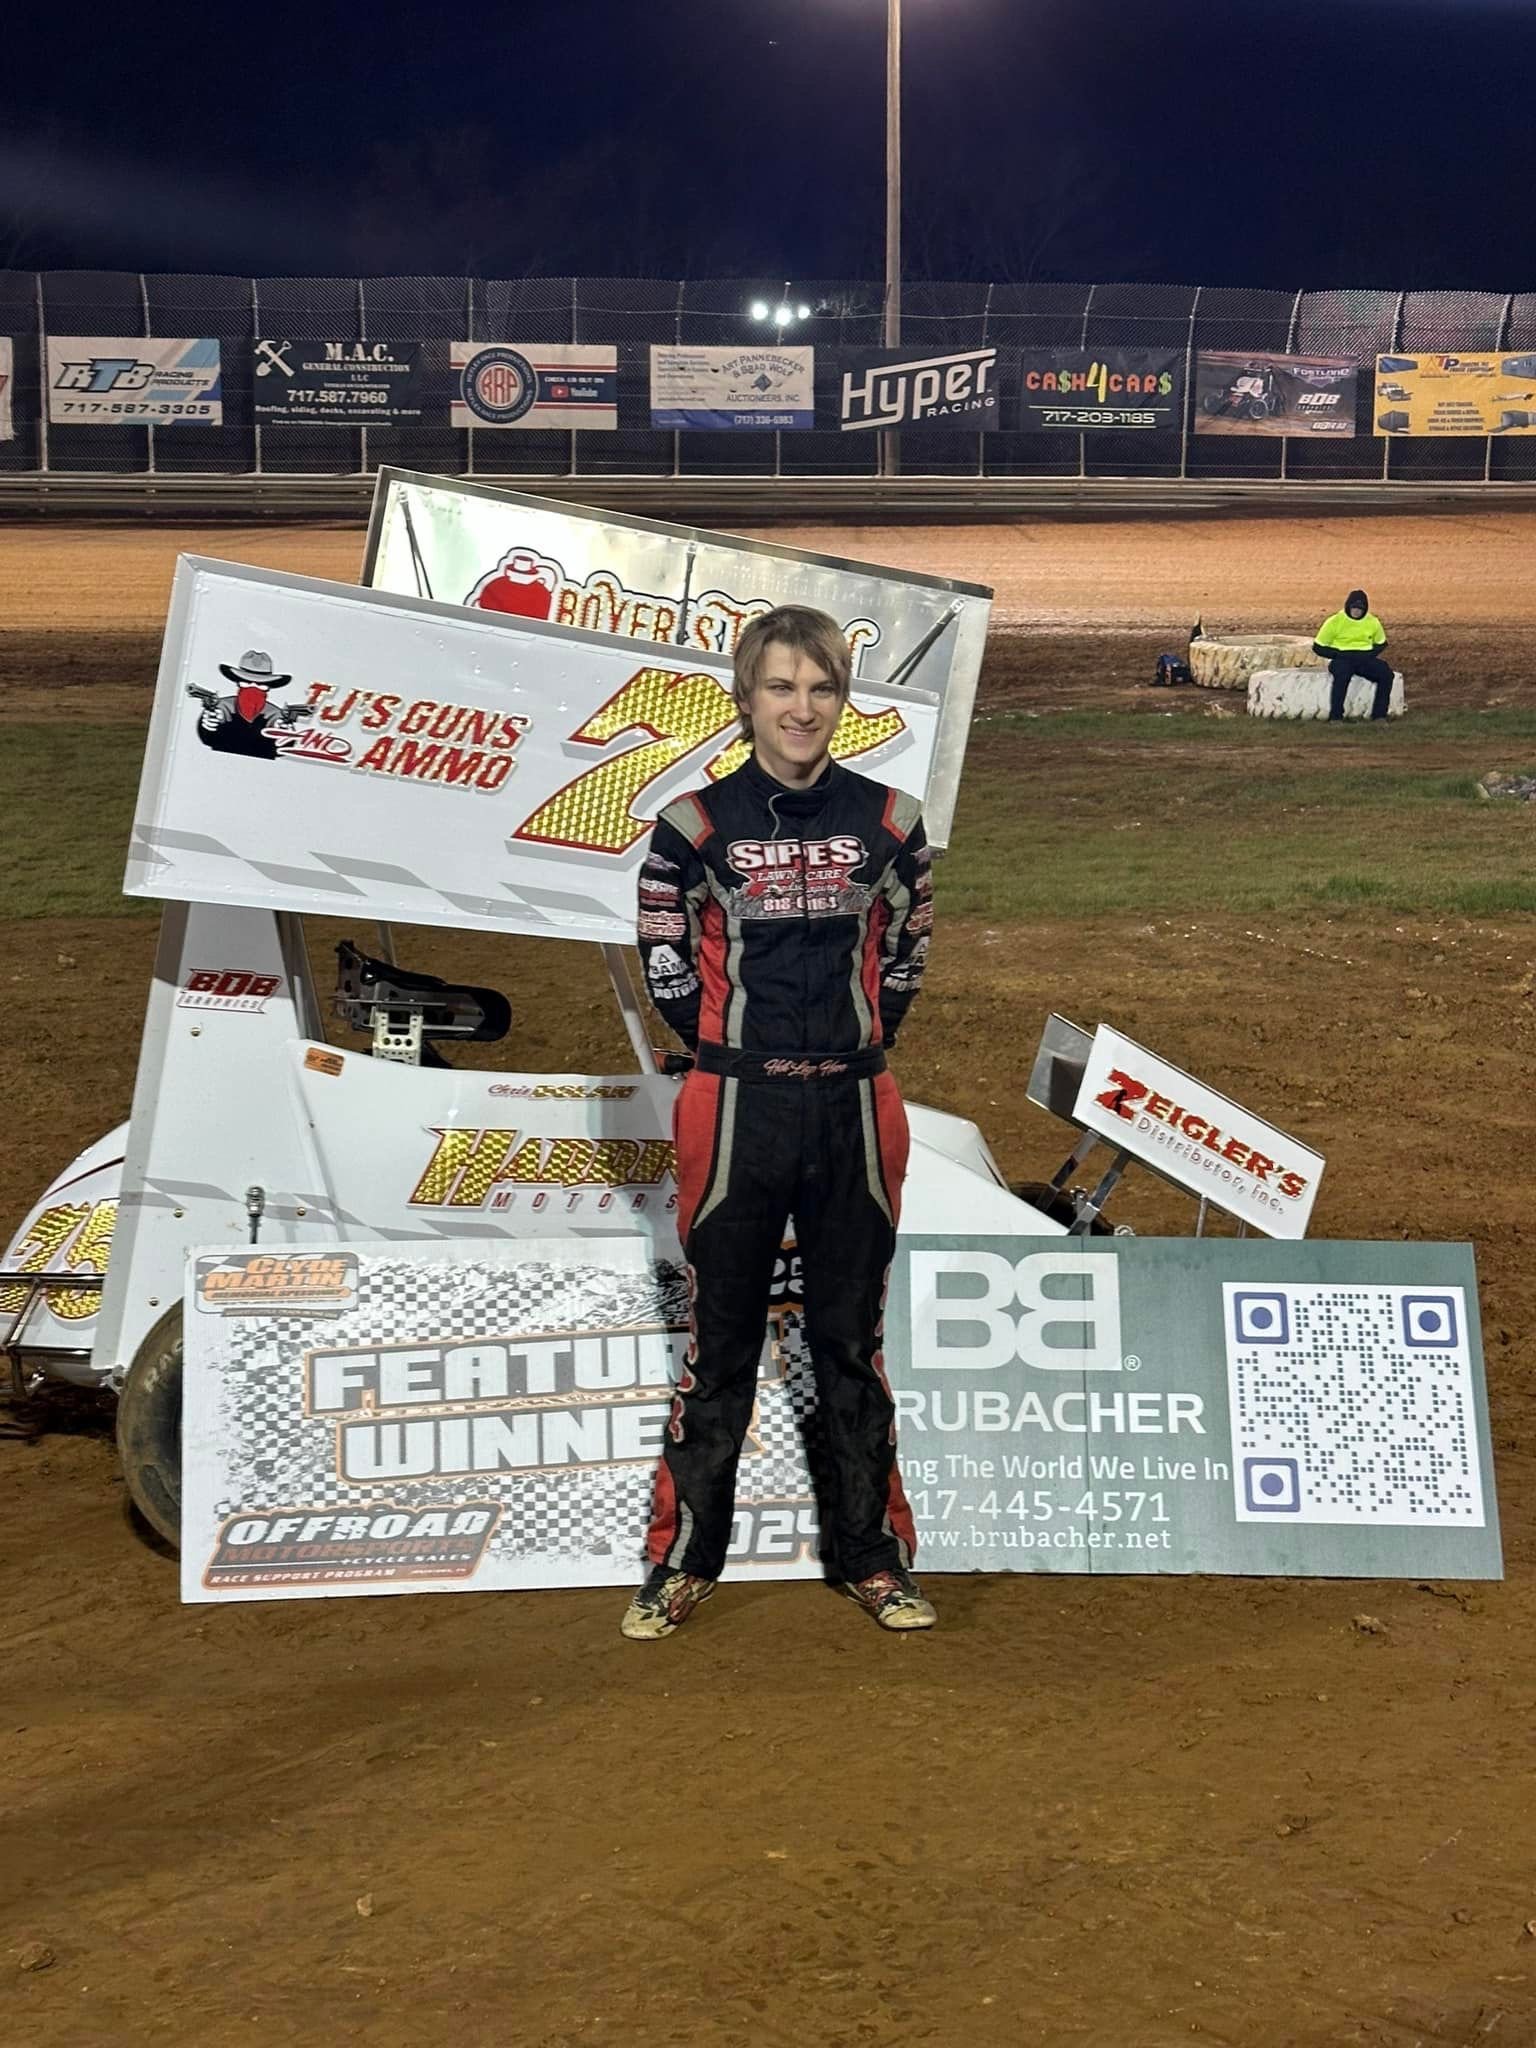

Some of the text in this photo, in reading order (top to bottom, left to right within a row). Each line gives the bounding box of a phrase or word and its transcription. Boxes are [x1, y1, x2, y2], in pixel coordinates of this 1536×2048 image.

[325, 342, 395, 362] M.A.C.
[53, 358, 156, 393] RTB
[154, 370, 193, 378] RACING
[351, 374, 369, 382] LLC
[287, 389, 388, 404] 717.587.7960
[842, 349, 996, 431] Hyper
[63, 402, 211, 415] 717-587-3305
[926, 397, 996, 418] RACING
[1042, 410, 1156, 425] 717-203-1185
[306, 682, 531, 749] TJ'S GUNS
[355, 734, 516, 791] AMMO
[732, 838, 861, 869] SIPES
[756, 869, 843, 882] LAWN CARE
[488, 1083, 530, 1098] Chris
[1094, 1068, 1308, 1199] ZEIGLER'S
[491, 1191, 678, 1209] MOTORS
[246, 1257, 348, 1274] CLYDE
[203, 1271, 345, 1290] MARTIN
[893, 1390, 1206, 1434] RUBACHER
[345, 1404, 671, 1479] WINNE
[945, 1454, 994, 1479] The
[1002, 1455, 1083, 1480] World
[1090, 1456, 1135, 1480] We
[1143, 1456, 1196, 1481] Live
[1204, 1457, 1229, 1481] In
[904, 1489, 1170, 1522] 17-445-4571
[226, 1510, 491, 1546] OFFROAD
[917, 1525, 1171, 1550] ww.brubacher.net
[219, 1538, 476, 1563] MOTORSPORTS
[414, 1553, 472, 1563] SALES
[210, 1573, 247, 1584] RACE
[252, 1570, 320, 1583] SUPPORT
[324, 1567, 397, 1579] PROGRAM
